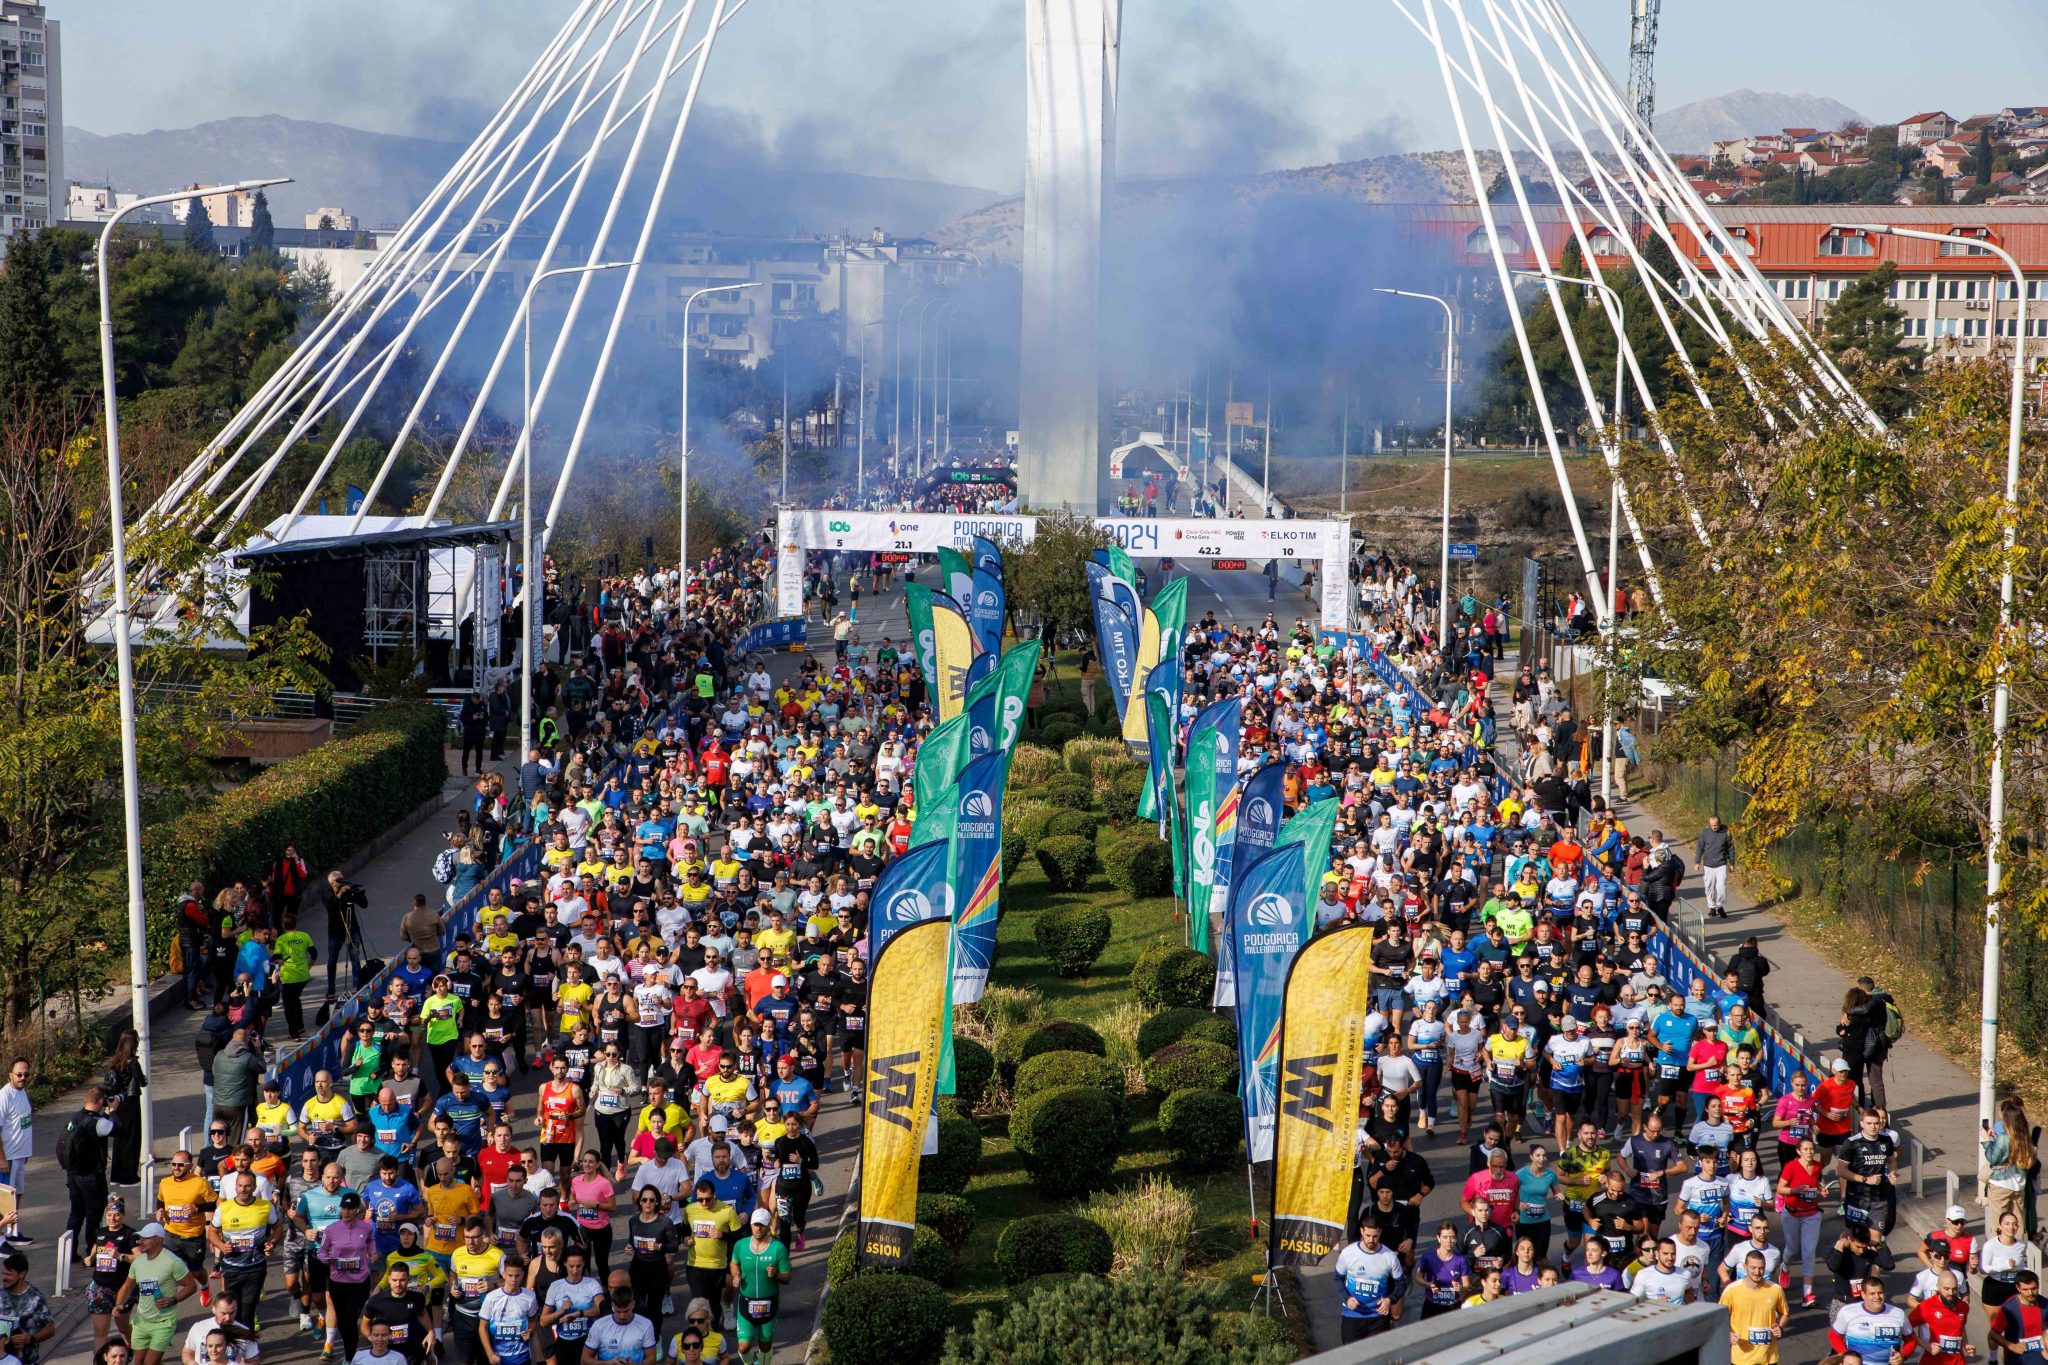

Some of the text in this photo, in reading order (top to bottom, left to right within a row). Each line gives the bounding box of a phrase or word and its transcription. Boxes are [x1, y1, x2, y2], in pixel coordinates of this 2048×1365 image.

[900, 523, 919, 532] one
[954, 521, 1023, 537] PODGORICA
[1103, 524, 1158, 550] 2024
[1270, 531, 1317, 540] ELKO TIM
[836, 539, 843, 547] 5
[894, 540, 913, 549] 21.1
[1198, 546, 1221, 555] 42.2
[1282, 547, 1294, 556] 10
[958, 822, 995, 834] PODGORICA
[1239, 825, 1275, 841] PODGORICA
[1244, 933, 1299, 945] PODGORICA
[777, 1090, 799, 1104] NYC
[907, 1017, 937, 1172] MULTISPORT AKADEMIJA MAYER
[1340, 1020, 1357, 1172] MULTISPORT AKADEMIJA MAYER
[785, 1168, 796, 1176] 944
[1706, 1189, 1717, 1197] 677
[866, 1242, 901, 1258] SSION
[1280, 1238, 1331, 1256] PASSION
[1361, 1284, 1372, 1292] 601
[502, 1327, 514, 1336] 636
[569, 1323, 582, 1331] 635
[1756, 1332, 1767, 1340] 927
[1882, 1328, 1894, 1337] 759
[2027, 1341, 2040, 1351] 755
